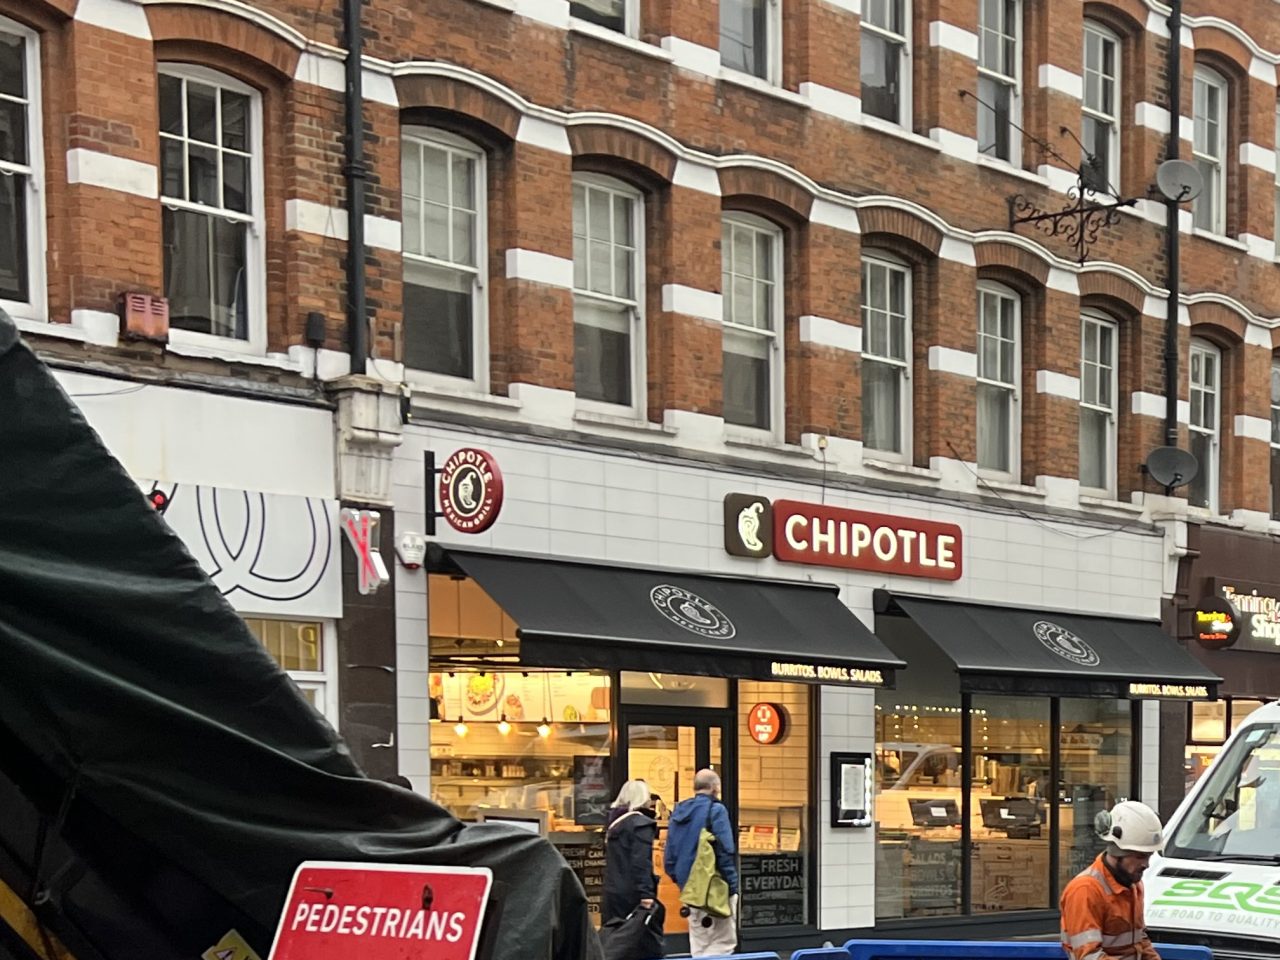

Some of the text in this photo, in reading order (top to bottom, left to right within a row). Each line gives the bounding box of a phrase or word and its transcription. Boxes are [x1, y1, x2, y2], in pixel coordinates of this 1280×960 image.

[442, 451, 493, 484] CHIPOTLE
[785, 514, 956, 569] CHIPOTLE
[1222, 585, 1280, 620] Tanning
[771, 661, 884, 683] BURRITOS. BOWLS. SALADS.
[761, 859, 799, 873] FRESH
[291, 903, 465, 943] PEDESTRIANS
[1146, 909, 1280, 929] THE ROAD TO QUALITY
